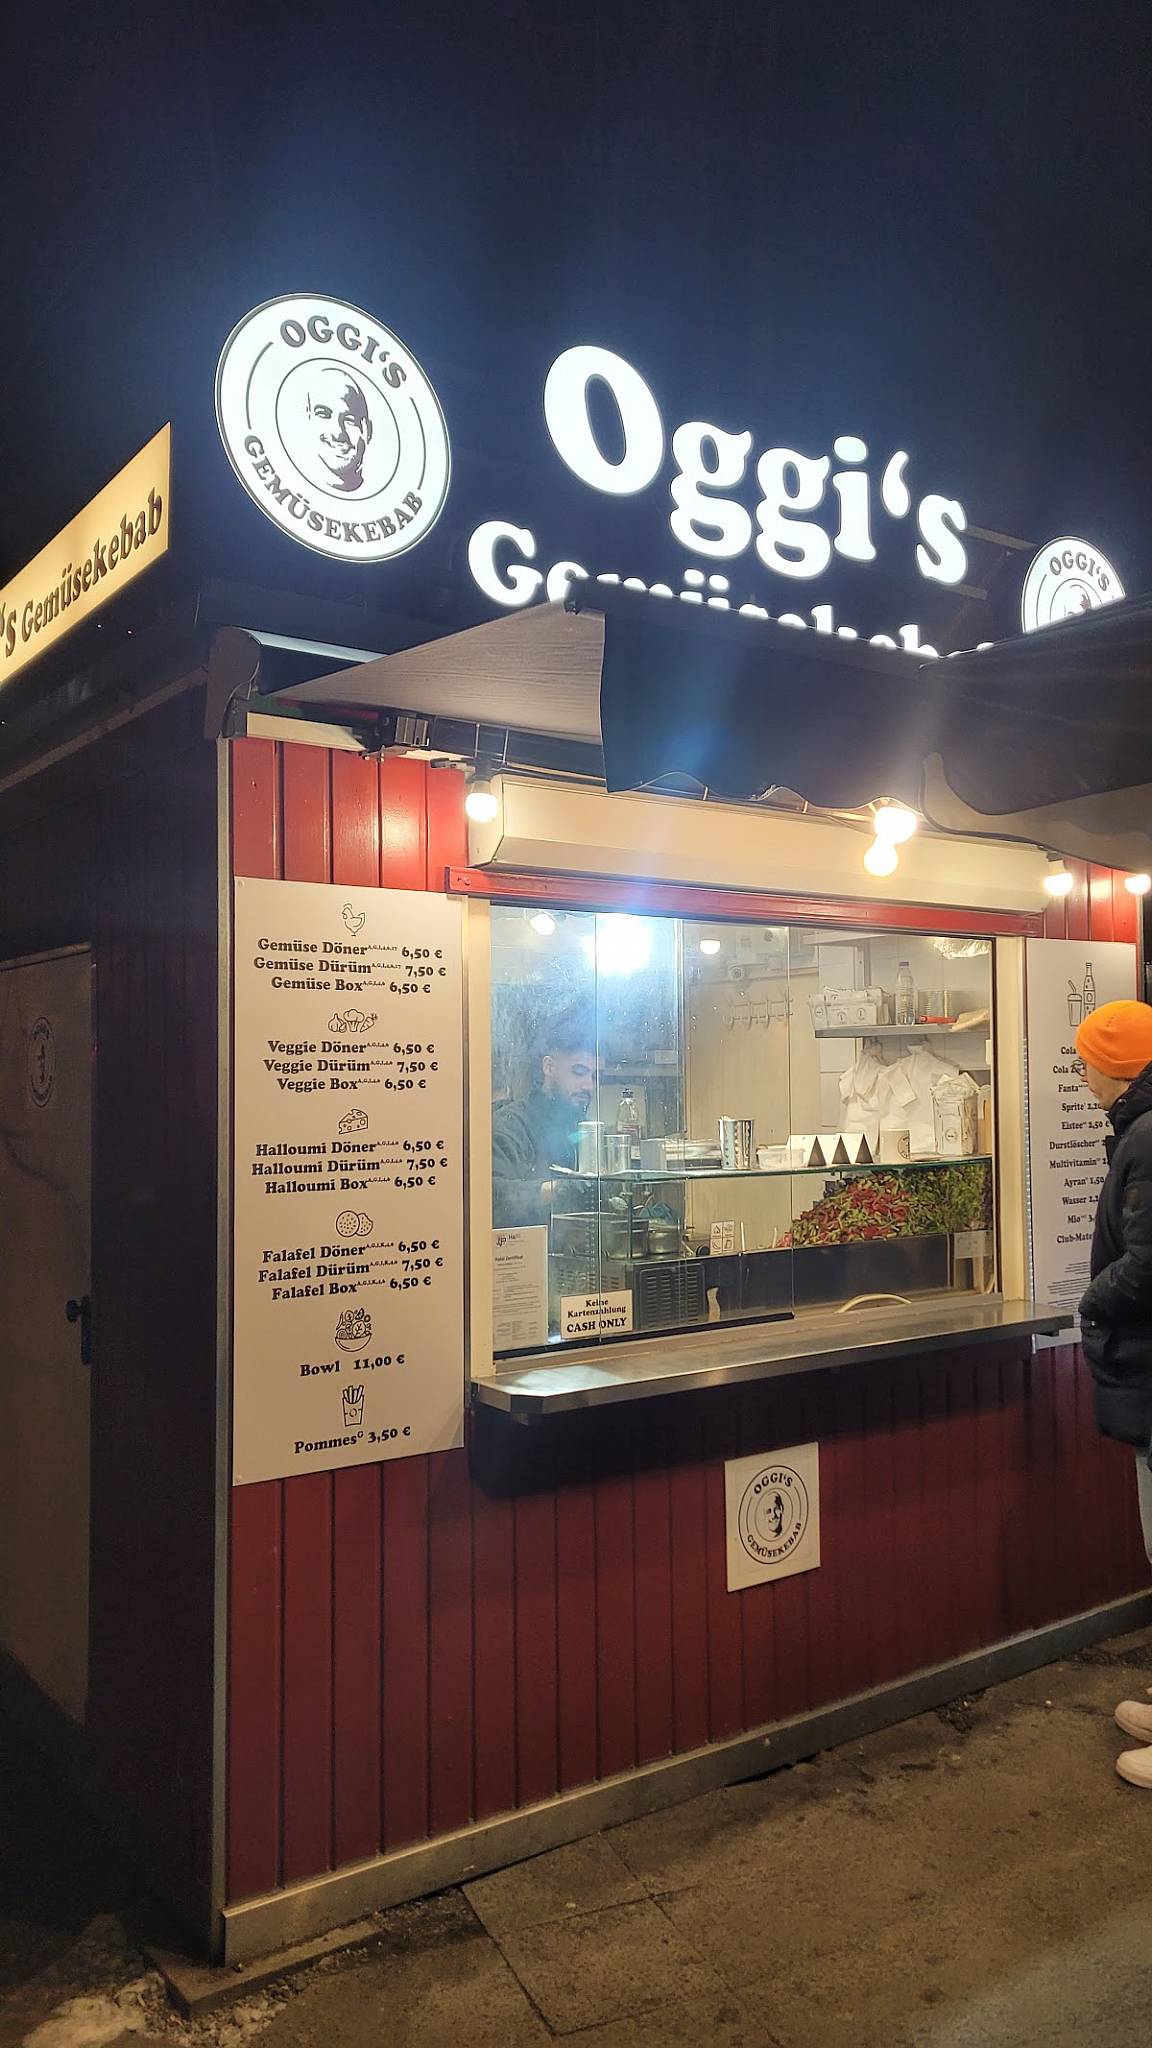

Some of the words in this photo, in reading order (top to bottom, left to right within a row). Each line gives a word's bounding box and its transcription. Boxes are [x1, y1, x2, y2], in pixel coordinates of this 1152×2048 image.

[244, 434, 423, 543] GEMÜSEKEBAB
[21, 487, 162, 642] Gemüsekebab
[258, 938, 318, 952] Gemüse
[401, 946, 430, 960] 6,50
[434, 949, 443, 959] €
[254, 957, 314, 971] Gemüse
[405, 965, 434, 978] 7,50
[438, 967, 447, 976] €
[271, 976, 331, 990] Gemüse
[389, 981, 418, 995] 6,50
[422, 984, 431, 993] €
[267, 1040, 317, 1055] Veggie
[393, 1043, 422, 1056] 6,50
[426, 1043, 435, 1054] €
[263, 1060, 313, 1075] Veggie
[397, 1061, 426, 1073] 7,50
[430, 1061, 439, 1071] €
[1053, 1065, 1069, 1073] Cola
[277, 1078, 326, 1093] Veggie
[384, 1078, 414, 1092] 6,50
[417, 1079, 426, 1089] €
[1058, 1083, 1078, 1092] Fanta
[256, 1143, 327, 1156] Halloumi
[403, 1139, 432, 1152] 6,50
[436, 1140, 445, 1150] €
[252, 1162, 323, 1175] Halloumi
[406, 1158, 435, 1171] 7,50
[439, 1157, 448, 1168] €
[1050, 1158, 1097, 1168] Multivitamin
[265, 1180, 336, 1194] Halloumi
[394, 1176, 423, 1189] 6,50
[427, 1176, 436, 1186] €
[1062, 1196, 1087, 1204] Wasser
[262, 1248, 316, 1263] Falafel
[398, 1240, 427, 1254] 6,50
[431, 1239, 440, 1249] €
[258, 1267, 312, 1282] Falafel
[402, 1258, 430, 1272] 7,50
[434, 1257, 443, 1267] €
[271, 1283, 324, 1300] Falafel
[389, 1277, 419, 1291] 6,50
[423, 1276, 432, 1286] €
[567, 1306, 626, 1318] Kartenzahlung
[567, 1320, 596, 1333] CASH
[599, 1317, 627, 1329] ONLY
[300, 1361, 340, 1377] Bowl
[353, 1355, 392, 1371] 11,00
[396, 1354, 405, 1364] €
[367, 1430, 398, 1443] 3,50
[402, 1426, 411, 1436] €
[753, 1472, 793, 1494] OGGI'S
[747, 1522, 802, 1558] GEMÜSEKEBAB
